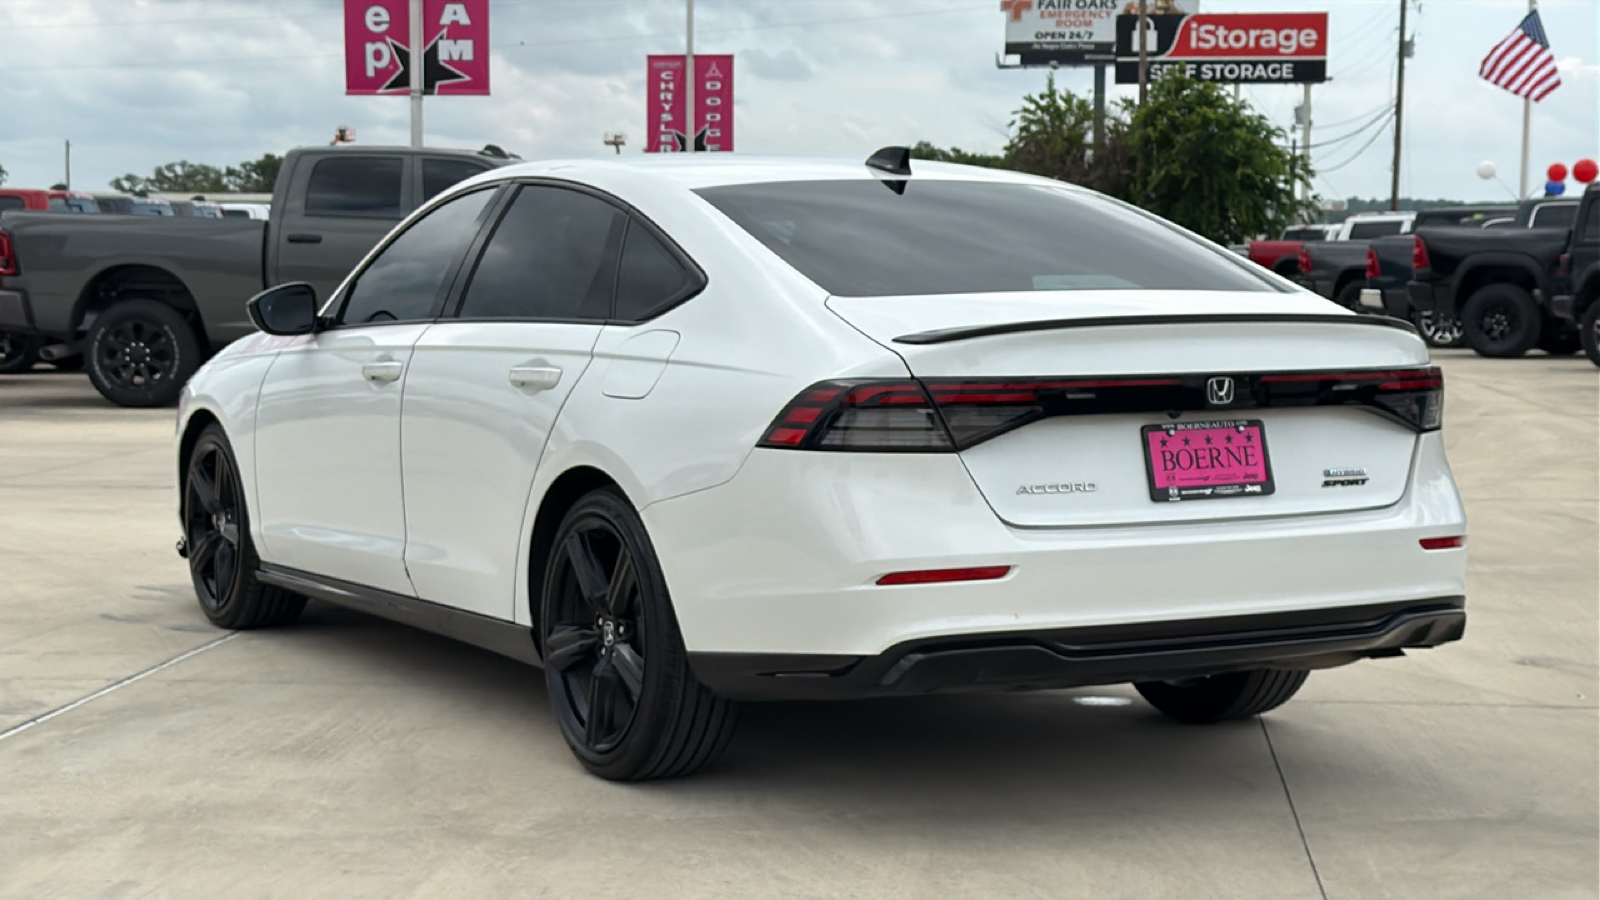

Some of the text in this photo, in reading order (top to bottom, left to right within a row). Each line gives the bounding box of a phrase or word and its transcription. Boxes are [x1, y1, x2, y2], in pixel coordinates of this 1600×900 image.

[1038, 0, 1118, 10] FAIR OAKS
[1040, 10, 1112, 19] EMERGENCY
[1055, 19, 1093, 28] ROOM
[1034, 30, 1094, 40] OPEN 24/7
[1190, 21, 1318, 54] iStorage
[1200, 63, 1294, 80] STORAGE
[660, 70, 675, 152] CHRYSLER
[705, 80, 721, 152] DODGE
[1161, 445, 1258, 471] BOERNE
[1016, 482, 1098, 495] ACCORD
[1321, 477, 1369, 488] SPORT
